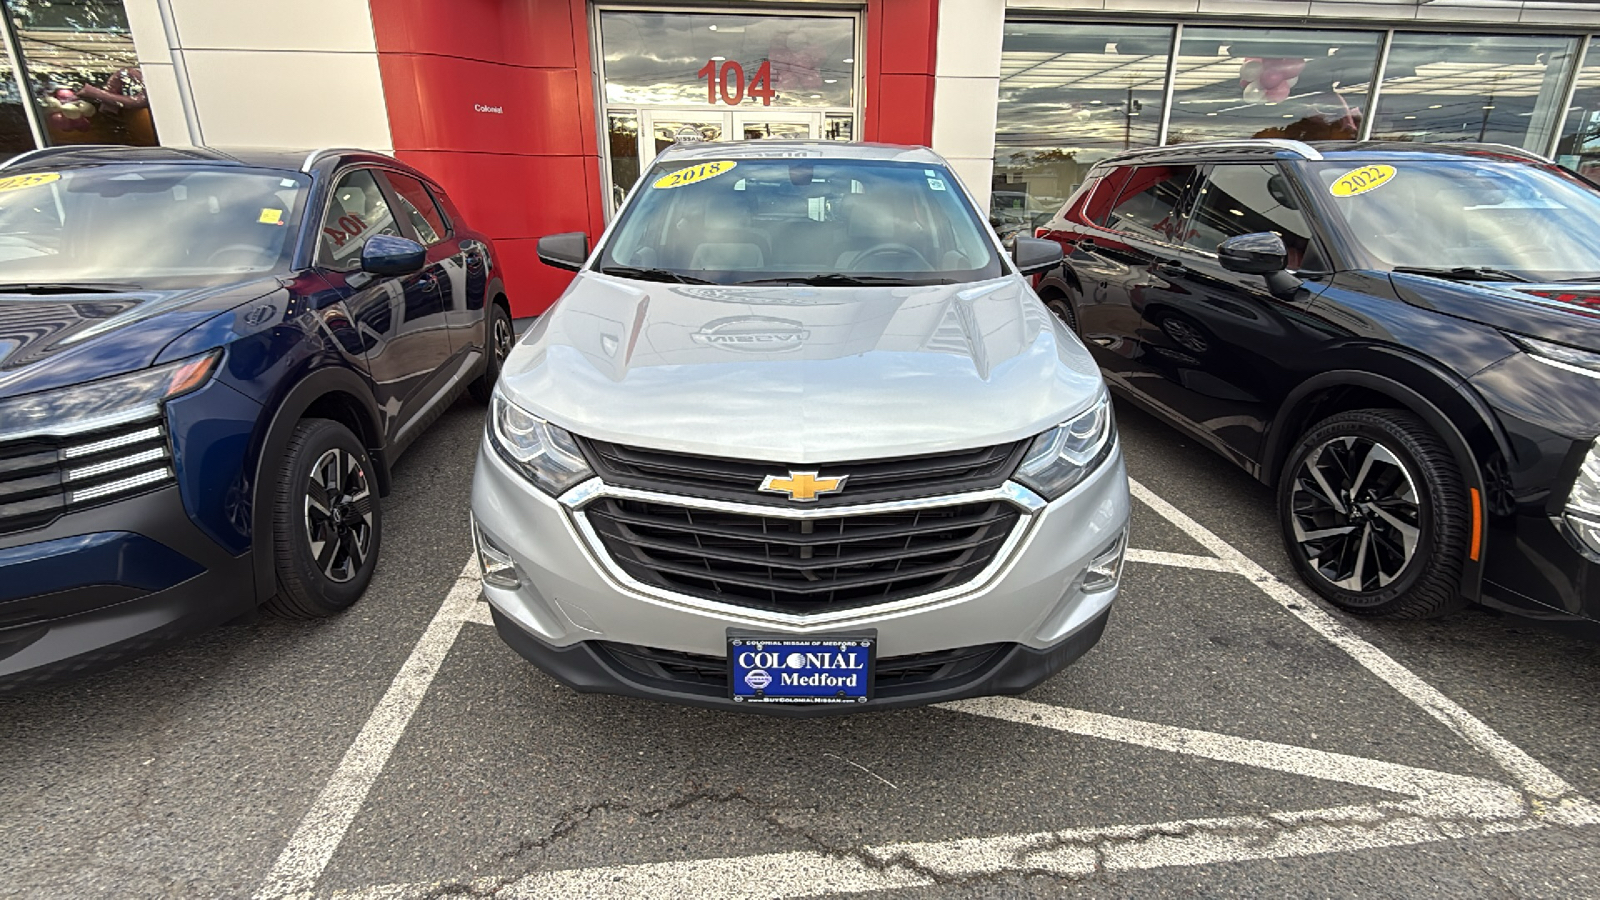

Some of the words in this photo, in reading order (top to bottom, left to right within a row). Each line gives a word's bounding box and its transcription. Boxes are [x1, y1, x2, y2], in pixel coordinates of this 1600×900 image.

[698, 59, 776, 106] 104
[474, 103, 503, 114] Colonial
[670, 163, 720, 186] 2018
[1341, 167, 1386, 193] 2022
[738, 652, 864, 669] COLONIAL
[780, 673, 857, 687] Medford
